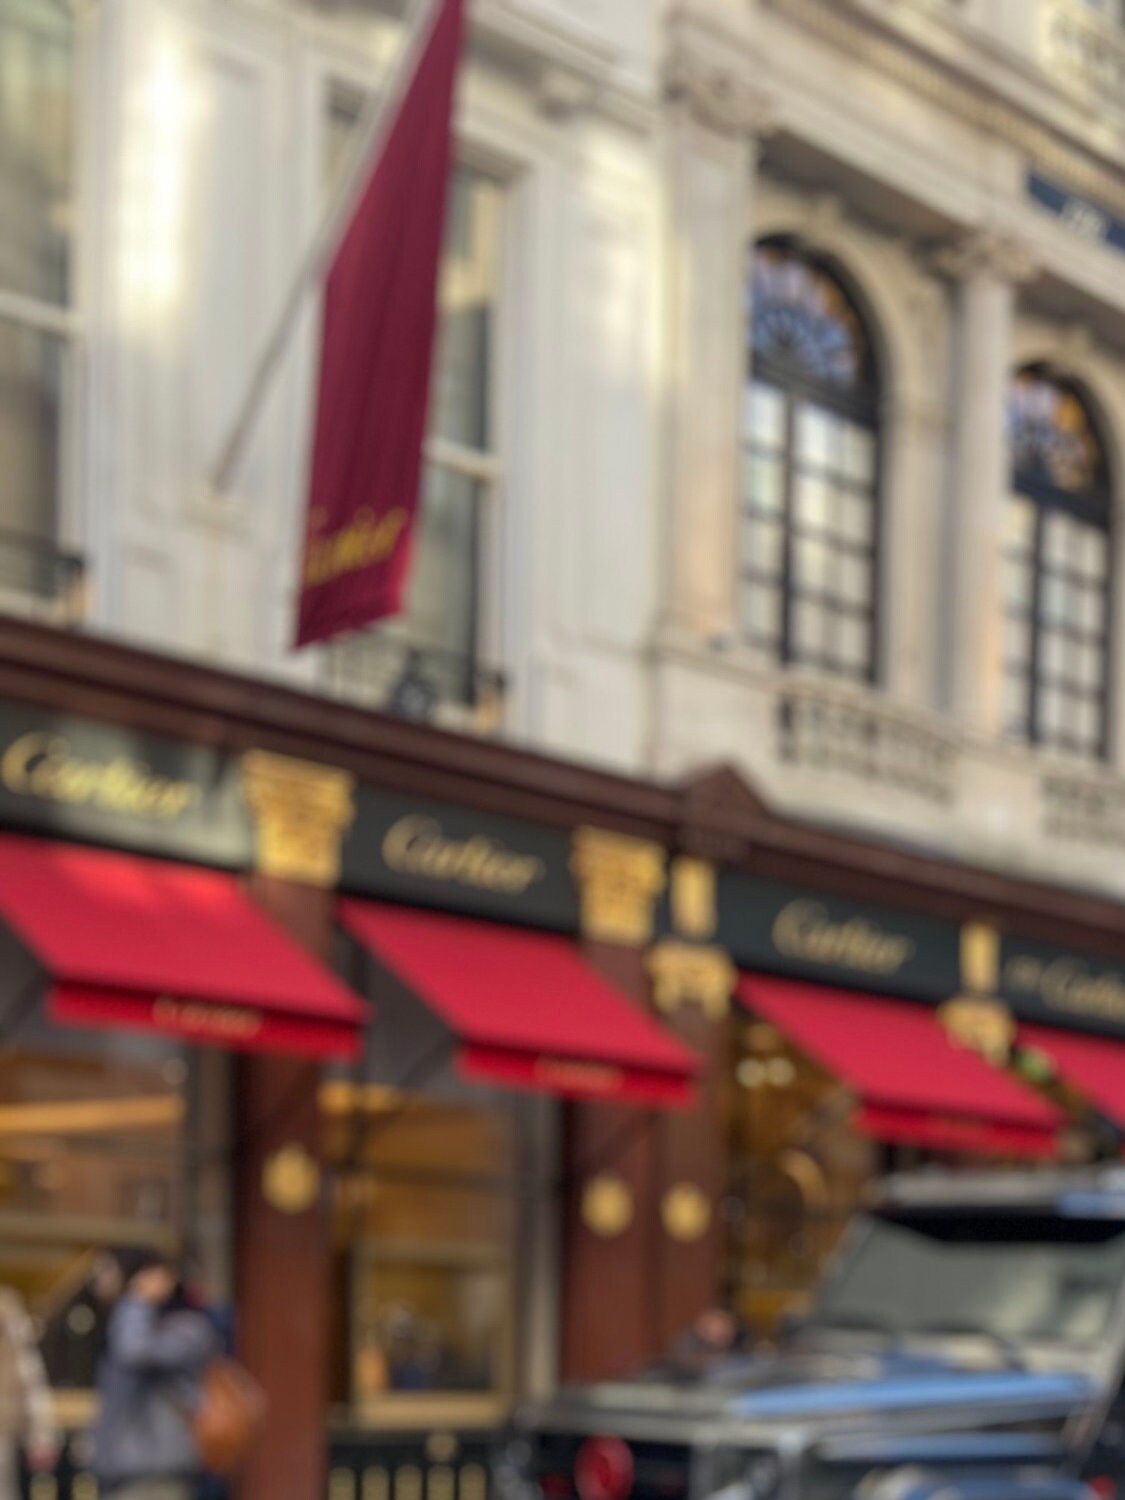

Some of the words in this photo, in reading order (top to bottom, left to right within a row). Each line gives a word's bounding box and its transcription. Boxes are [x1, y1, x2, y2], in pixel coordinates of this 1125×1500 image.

[2, 731, 194, 821] Cartier
[382, 815, 546, 894] Cartier
[772, 898, 917, 975] Cartier
